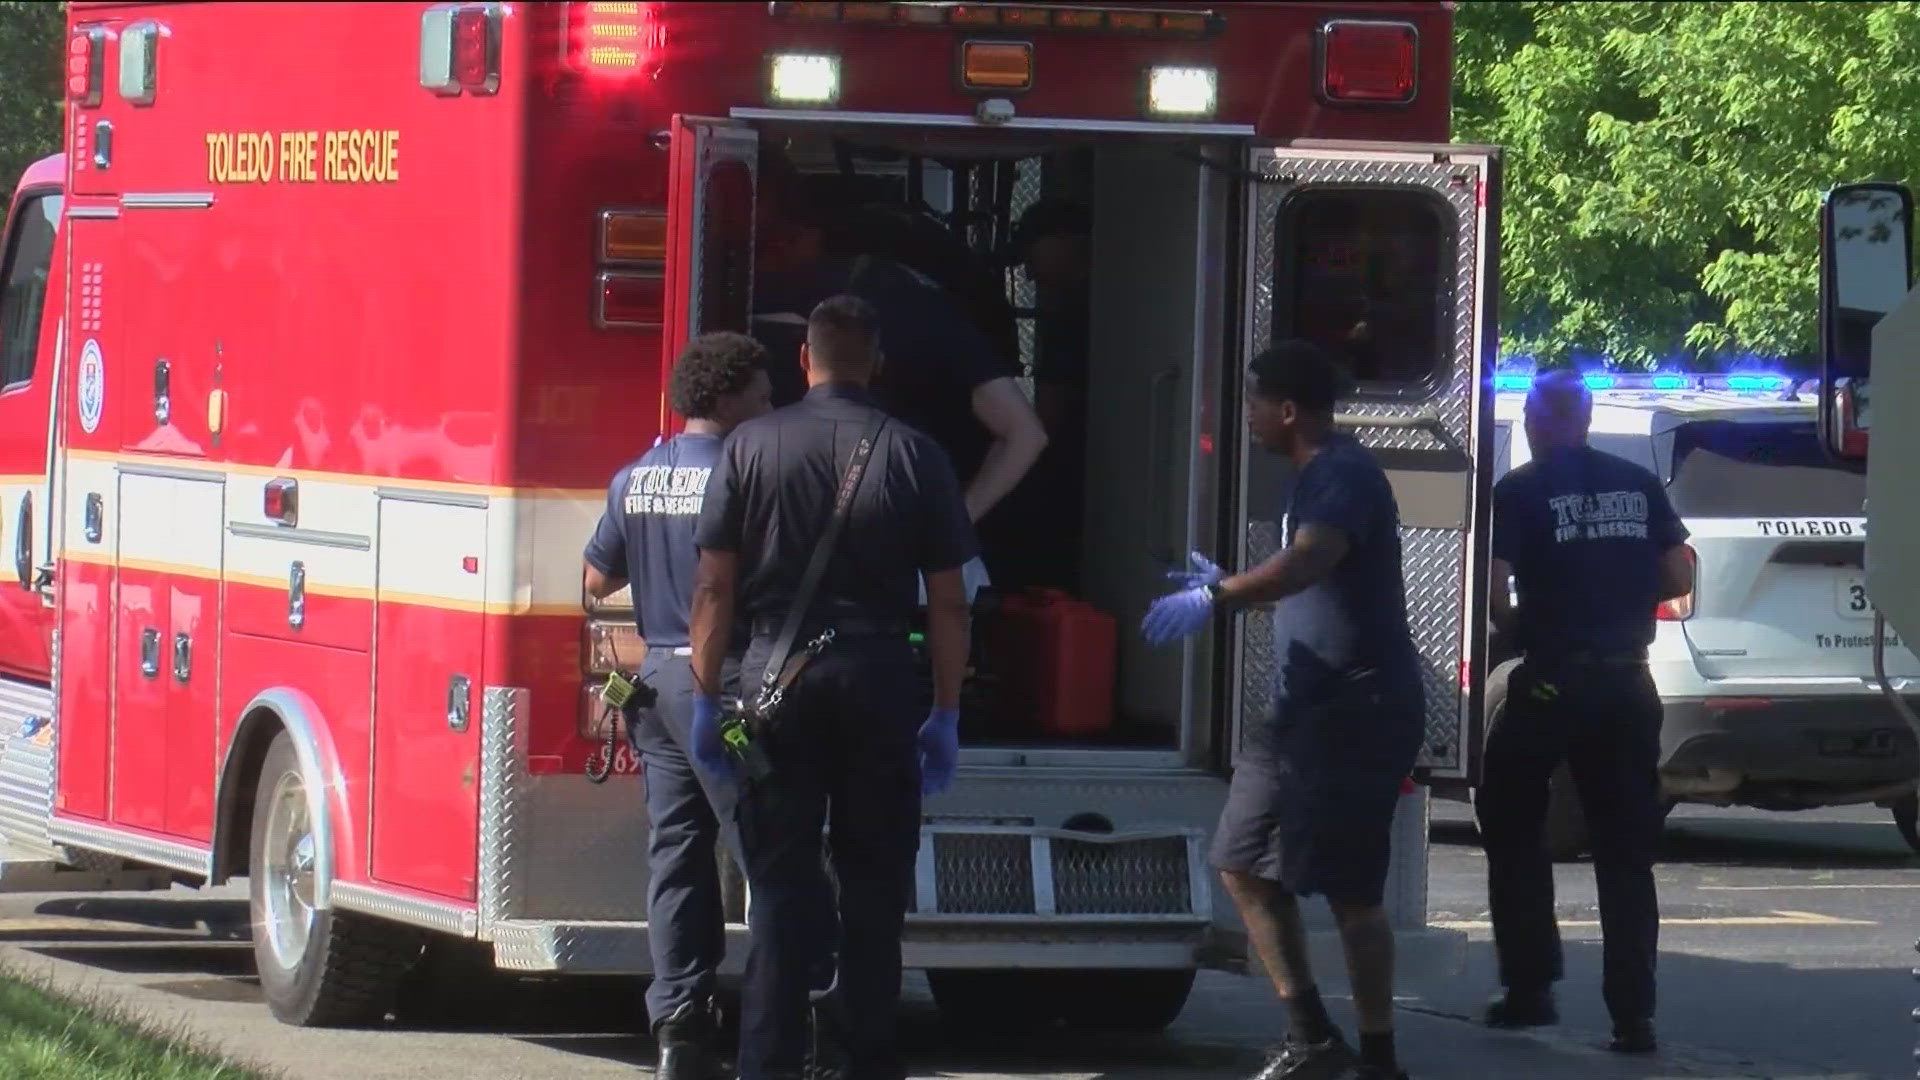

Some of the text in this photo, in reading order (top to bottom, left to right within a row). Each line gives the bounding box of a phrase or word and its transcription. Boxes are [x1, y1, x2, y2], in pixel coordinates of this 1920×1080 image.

[205, 129, 400, 183] TOLEDO FIRE RESCUE
[625, 495, 653, 514] FIRE
[652, 497, 665, 513] &
[1758, 521, 1853, 536] TOLEDO
[1816, 634, 1832, 648] To
